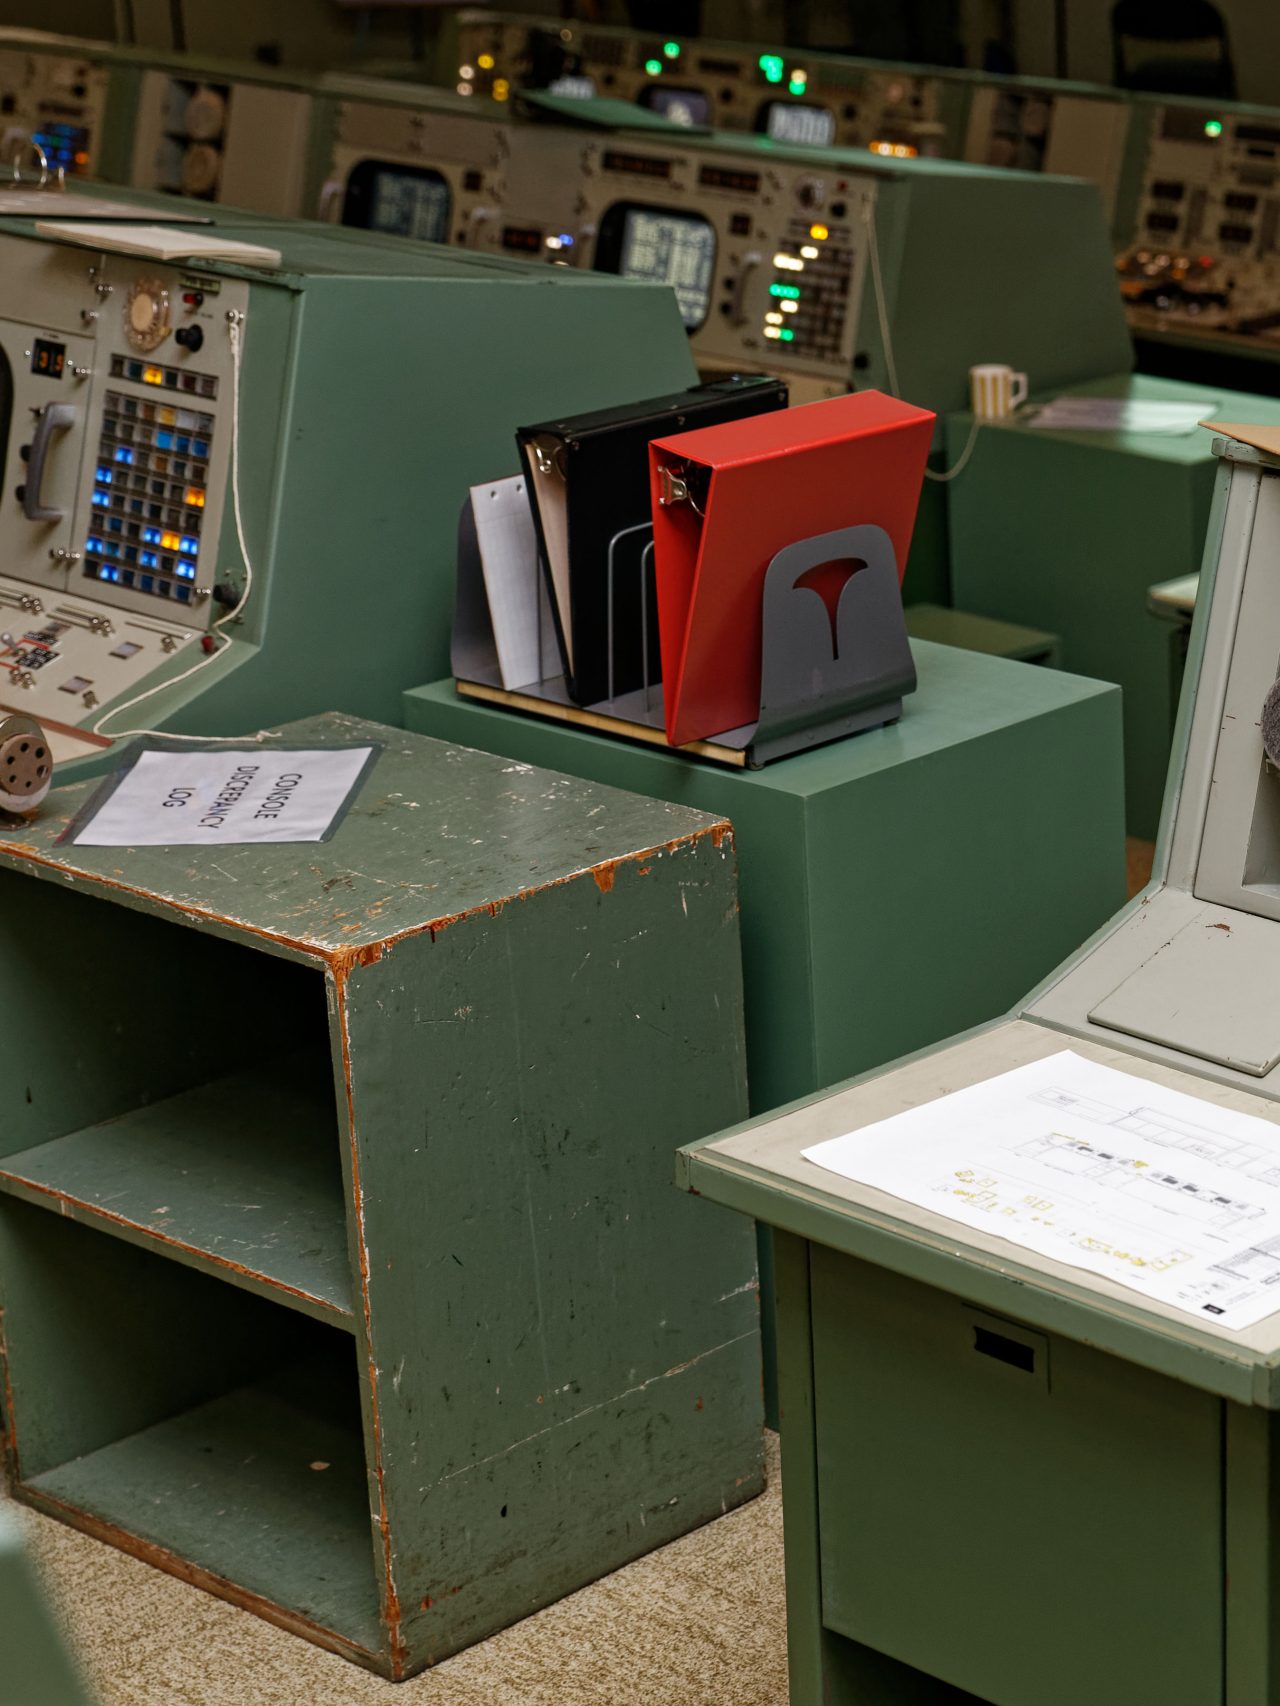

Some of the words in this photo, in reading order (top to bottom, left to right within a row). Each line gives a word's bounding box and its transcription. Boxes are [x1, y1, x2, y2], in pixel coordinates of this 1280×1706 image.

[162, 787, 197, 807] LOG
[198, 765, 260, 828] DISCREPANCY
[253, 773, 302, 819] CONSOLE
